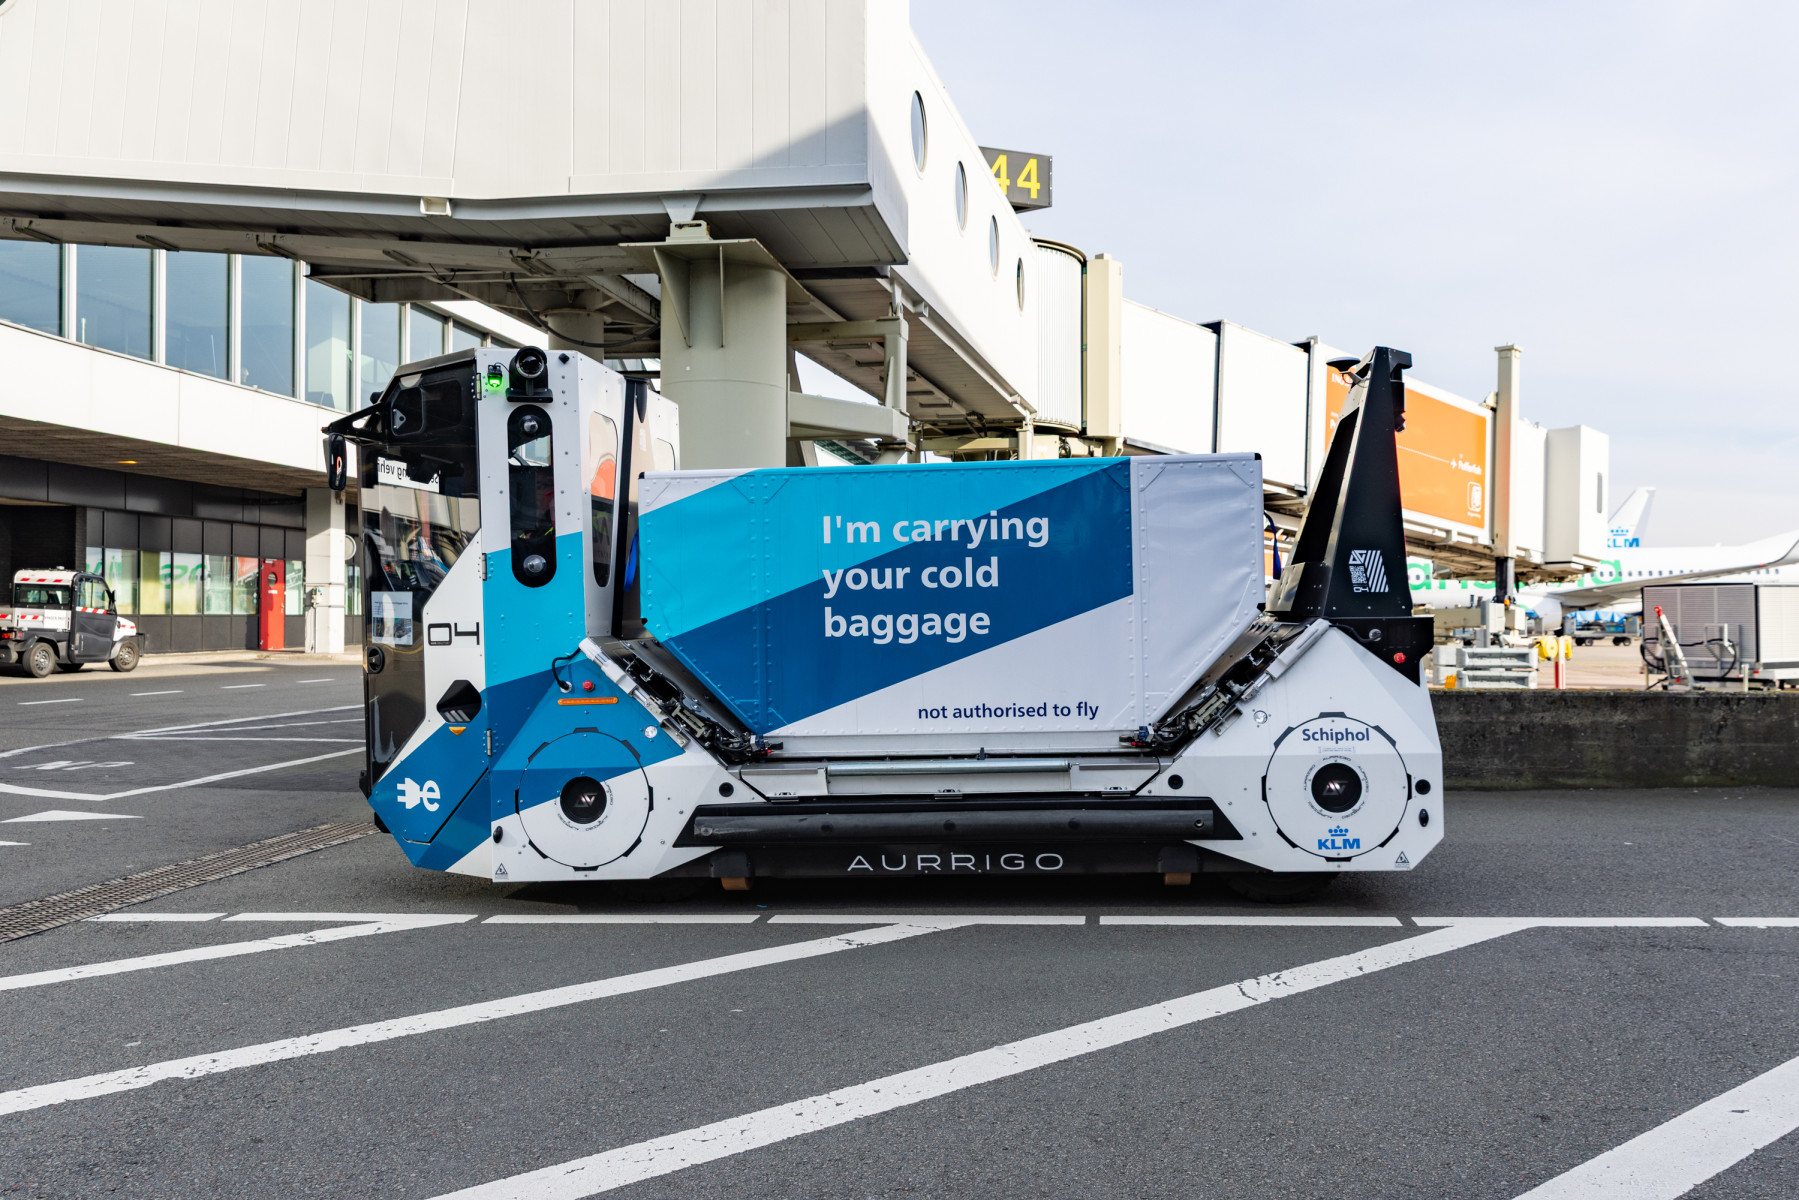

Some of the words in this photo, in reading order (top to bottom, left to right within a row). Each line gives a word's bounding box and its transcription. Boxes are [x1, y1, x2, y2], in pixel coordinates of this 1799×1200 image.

[991, 154, 1040, 199] 44
[823, 515, 881, 544] I'm
[892, 510, 1049, 549] carrying
[822, 567, 911, 599] your
[921, 556, 999, 588] cold
[428, 621, 480, 647] 04
[824, 606, 991, 645] baggage
[918, 705, 948, 719] not
[952, 702, 1047, 719] authorised
[1053, 703, 1071, 717] to
[1076, 701, 1099, 720] fly
[1302, 727, 1370, 744] Schiphol
[1317, 838, 1361, 850] KLM
[847, 853, 1064, 872] AURRIGO
